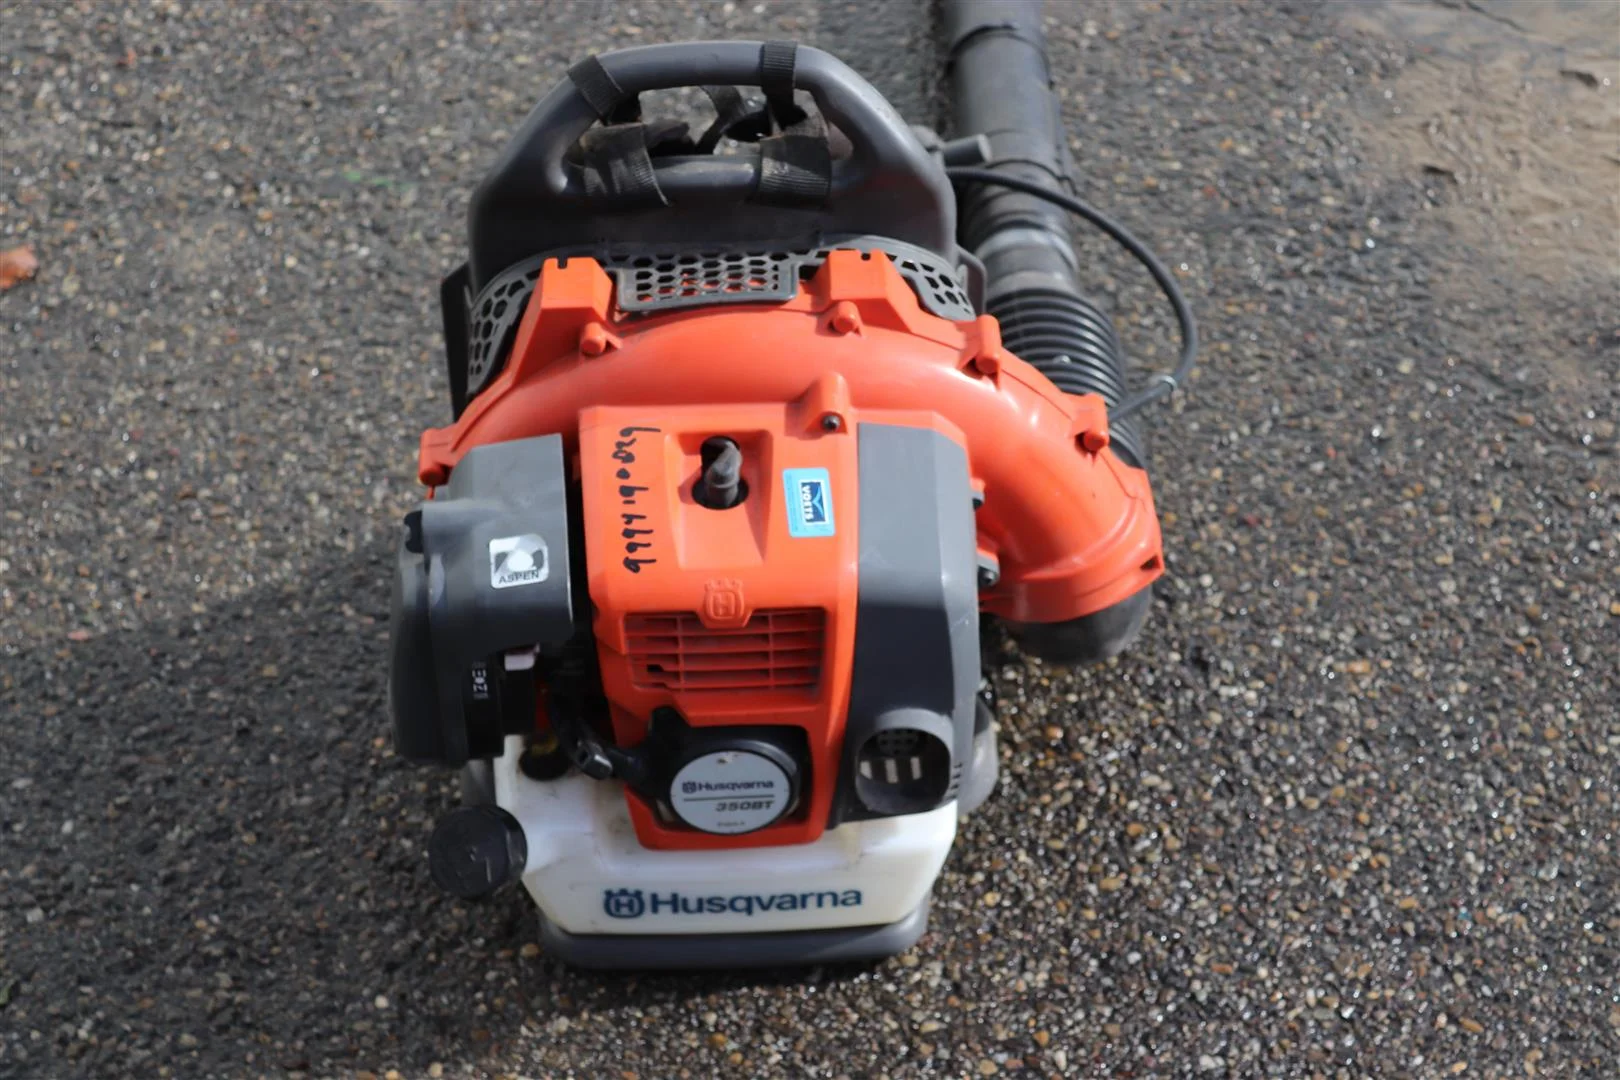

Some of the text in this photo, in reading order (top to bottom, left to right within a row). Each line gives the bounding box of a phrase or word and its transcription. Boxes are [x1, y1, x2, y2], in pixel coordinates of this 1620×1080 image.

[498, 569, 540, 585] ASPEN
[698, 780, 775, 793] Husqvarna
[650, 888, 863, 917] Husqvarna
